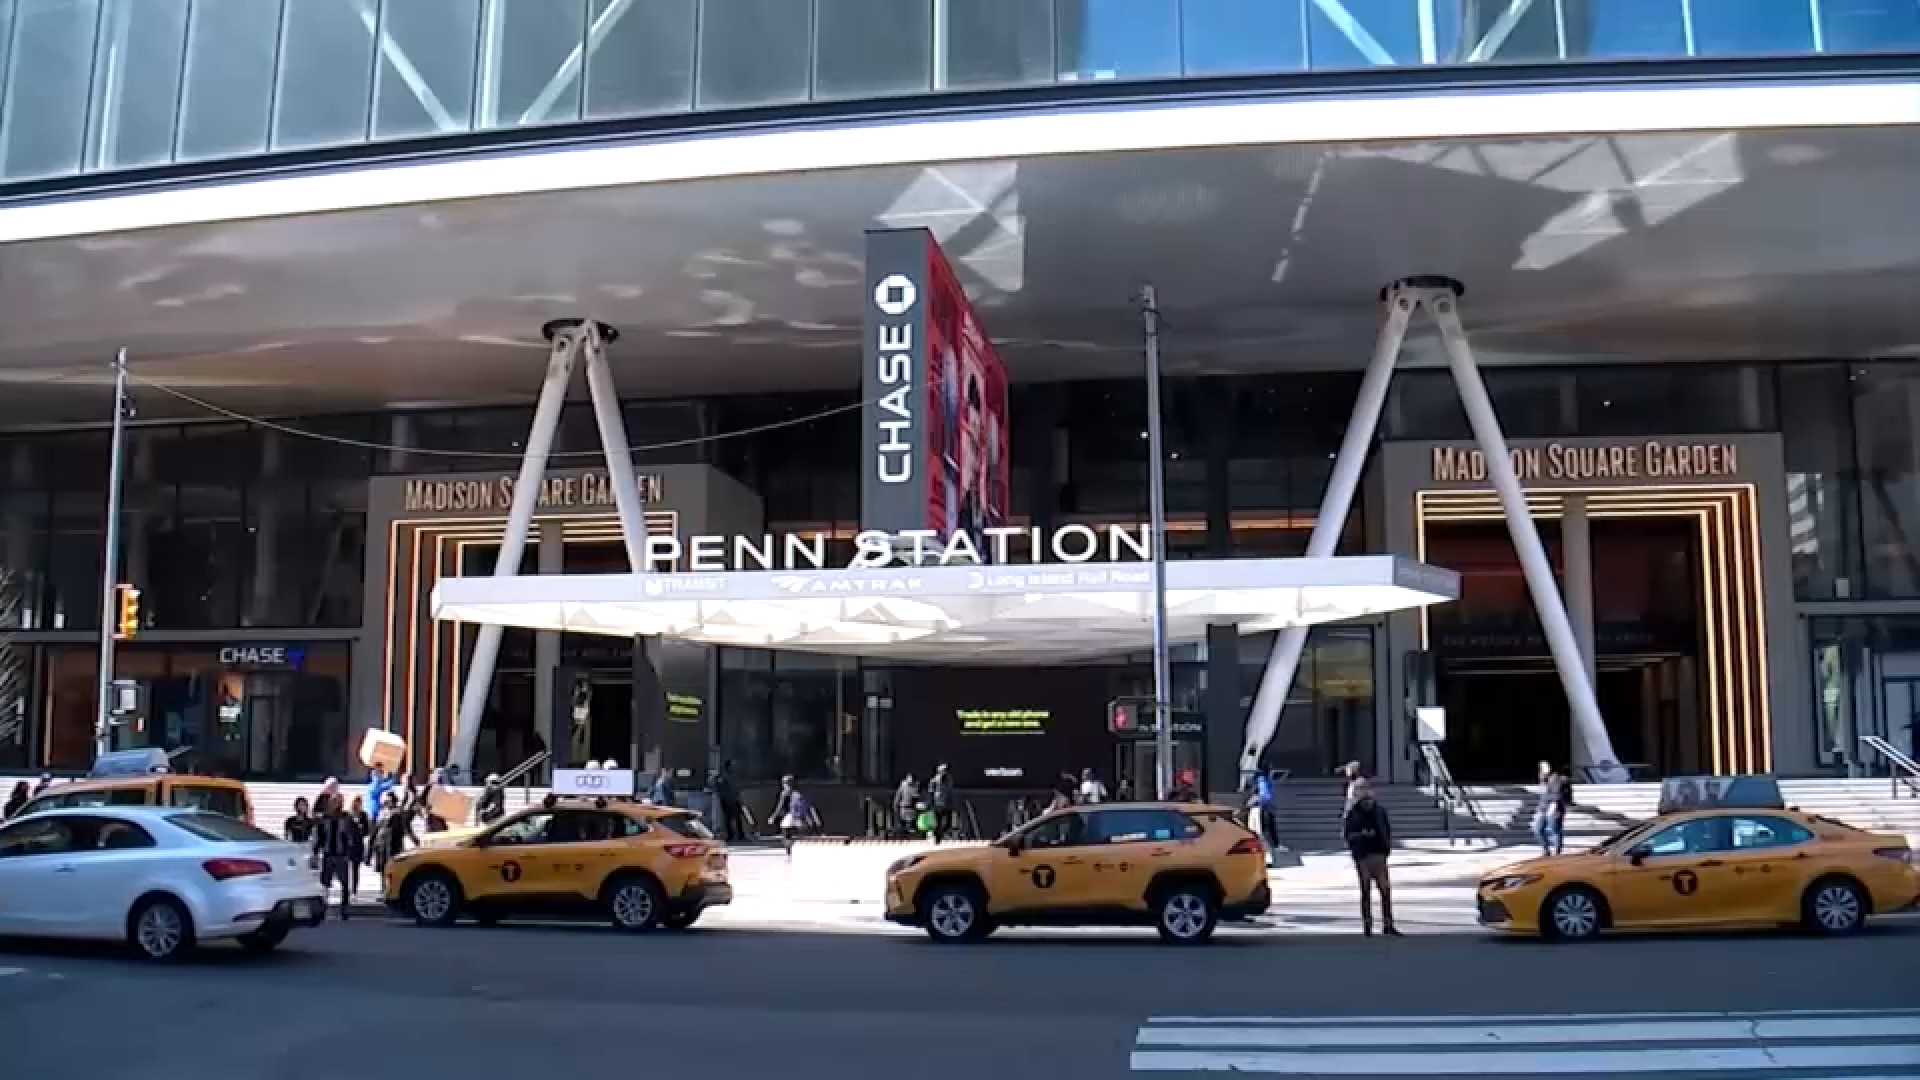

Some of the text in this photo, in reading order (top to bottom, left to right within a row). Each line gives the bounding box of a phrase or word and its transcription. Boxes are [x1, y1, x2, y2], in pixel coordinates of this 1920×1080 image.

[879, 323, 912, 483] CHASE
[1432, 441, 1737, 481] MADON SQUARE GARDEN
[404, 473, 662, 511] MADISON SARE GAEN
[645, 522, 1151, 572] PENN STATION
[811, 577, 923, 592] AMTRAK
[219, 647, 285, 663] CHASE
